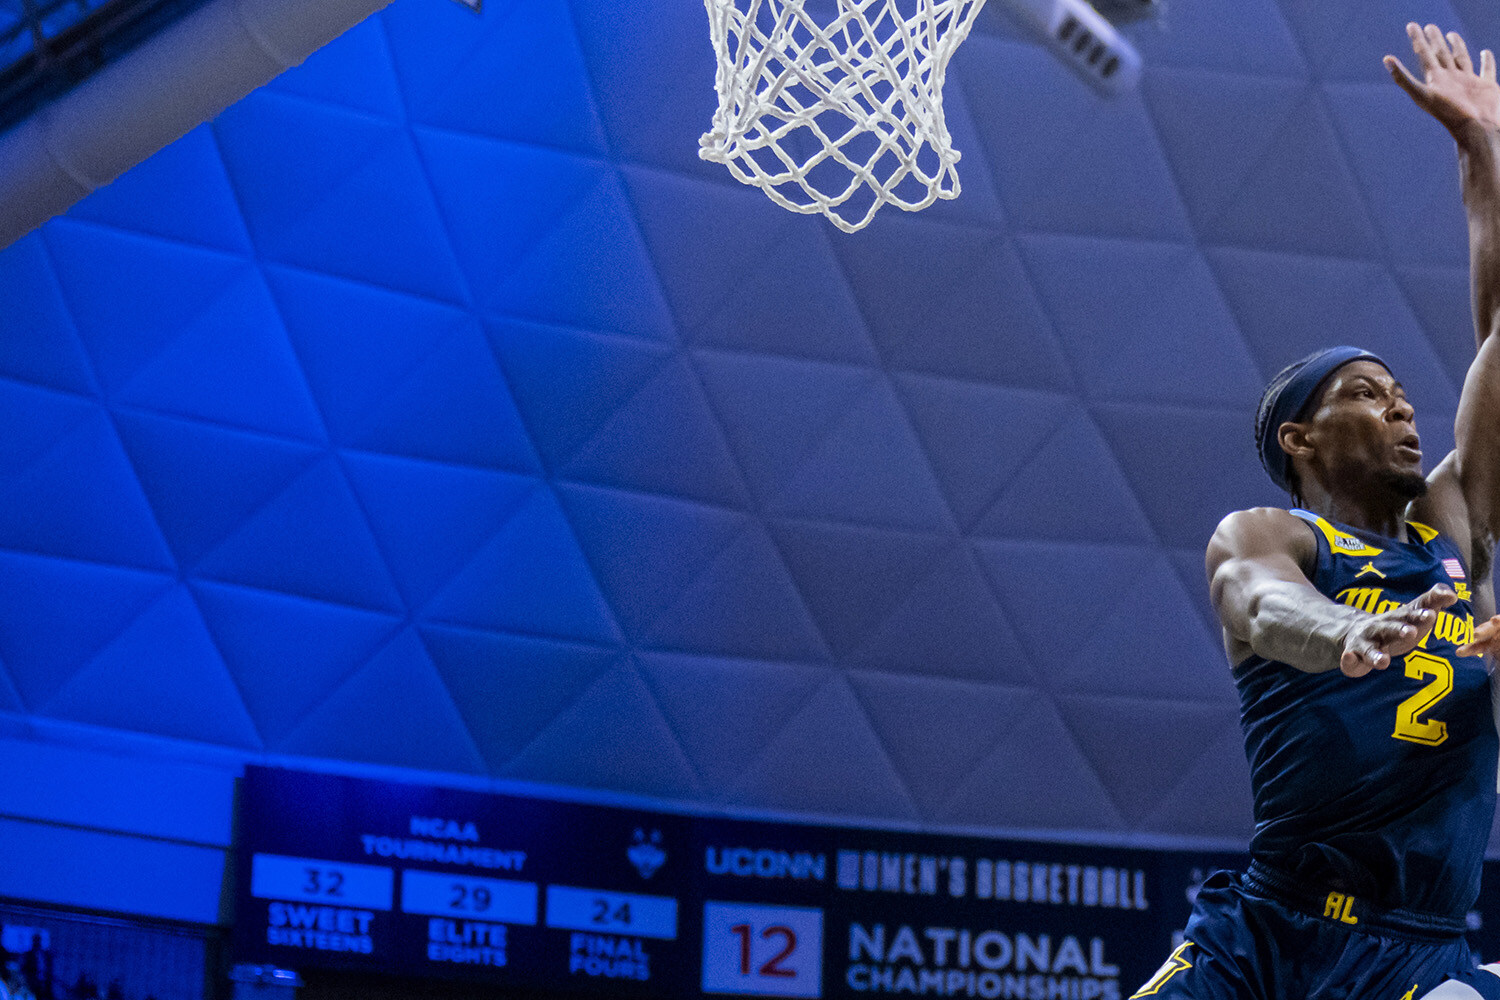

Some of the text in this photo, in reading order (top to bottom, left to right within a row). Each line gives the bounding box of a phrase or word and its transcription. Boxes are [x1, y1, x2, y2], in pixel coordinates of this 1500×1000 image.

[1391, 650, 1454, 747] 2
[410, 815, 479, 842] NCAA
[362, 834, 527, 871] TOURNAMENT
[303, 868, 344, 895] 32
[705, 847, 1148, 909] UCONN WOMEN'S BASKETBALL
[450, 884, 492, 911] 29
[268, 903, 374, 935] SWEET
[591, 899, 631, 926] 24
[267, 926, 373, 954] SIXTEENS
[428, 918, 507, 948] ELITE
[570, 932, 649, 961] FINAL
[427, 941, 507, 967] EIGHTS
[731, 924, 798, 978] 12
[849, 923, 1119, 977] NATIONAL
[569, 954, 650, 981] FOURS
